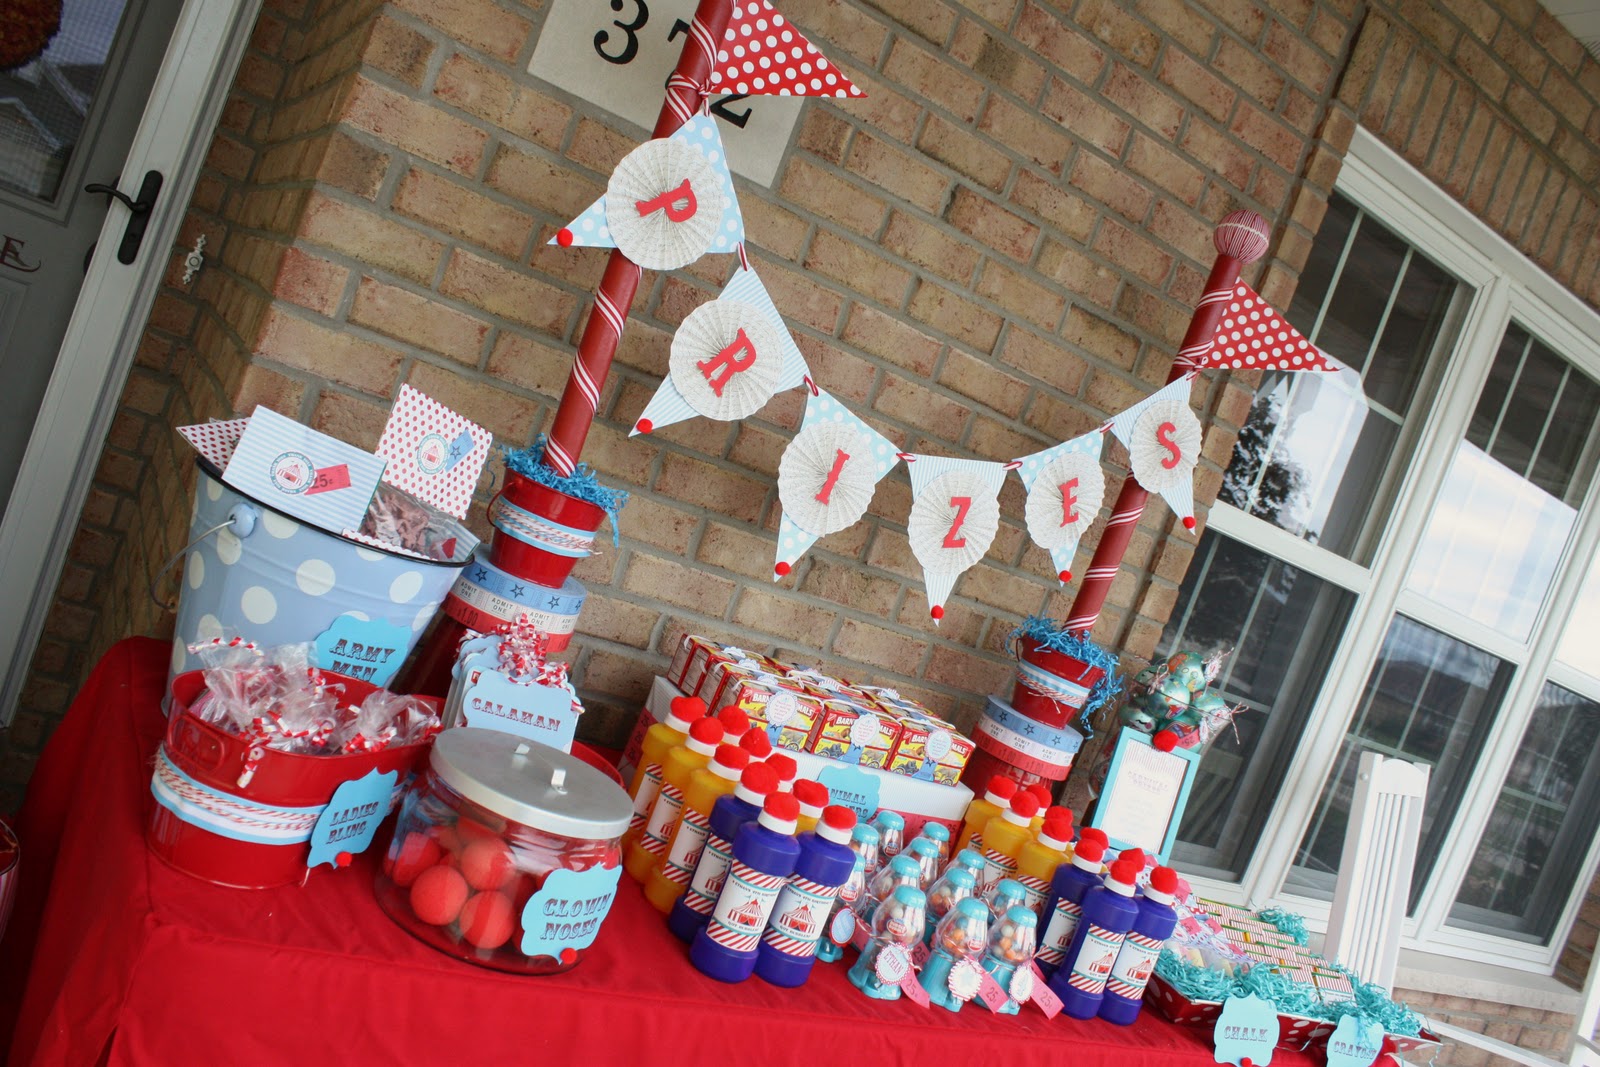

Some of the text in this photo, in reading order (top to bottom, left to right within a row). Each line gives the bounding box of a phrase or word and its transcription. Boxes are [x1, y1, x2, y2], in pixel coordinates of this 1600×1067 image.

[461, 581, 477, 594] ADMIT
[461, 588, 472, 598] ONE
[491, 598, 513, 610] ADMIT
[493, 605, 507, 614] ONE
[529, 612, 550, 621] ADMIT
[531, 618, 543, 626] ONE
[329, 638, 396, 663] ARMY
[331, 660, 377, 682] MEN
[472, 698, 561, 731] CALAHAN
[827, 788, 866, 805] NIMAL
[329, 802, 379, 827] LADIES
[325, 821, 367, 845] BLING
[543, 893, 611, 917] CLOWN
[540, 917, 598, 940] NOSES
[883, 950, 904, 975] ETHAN
[1224, 1026, 1268, 1042] CHALK
